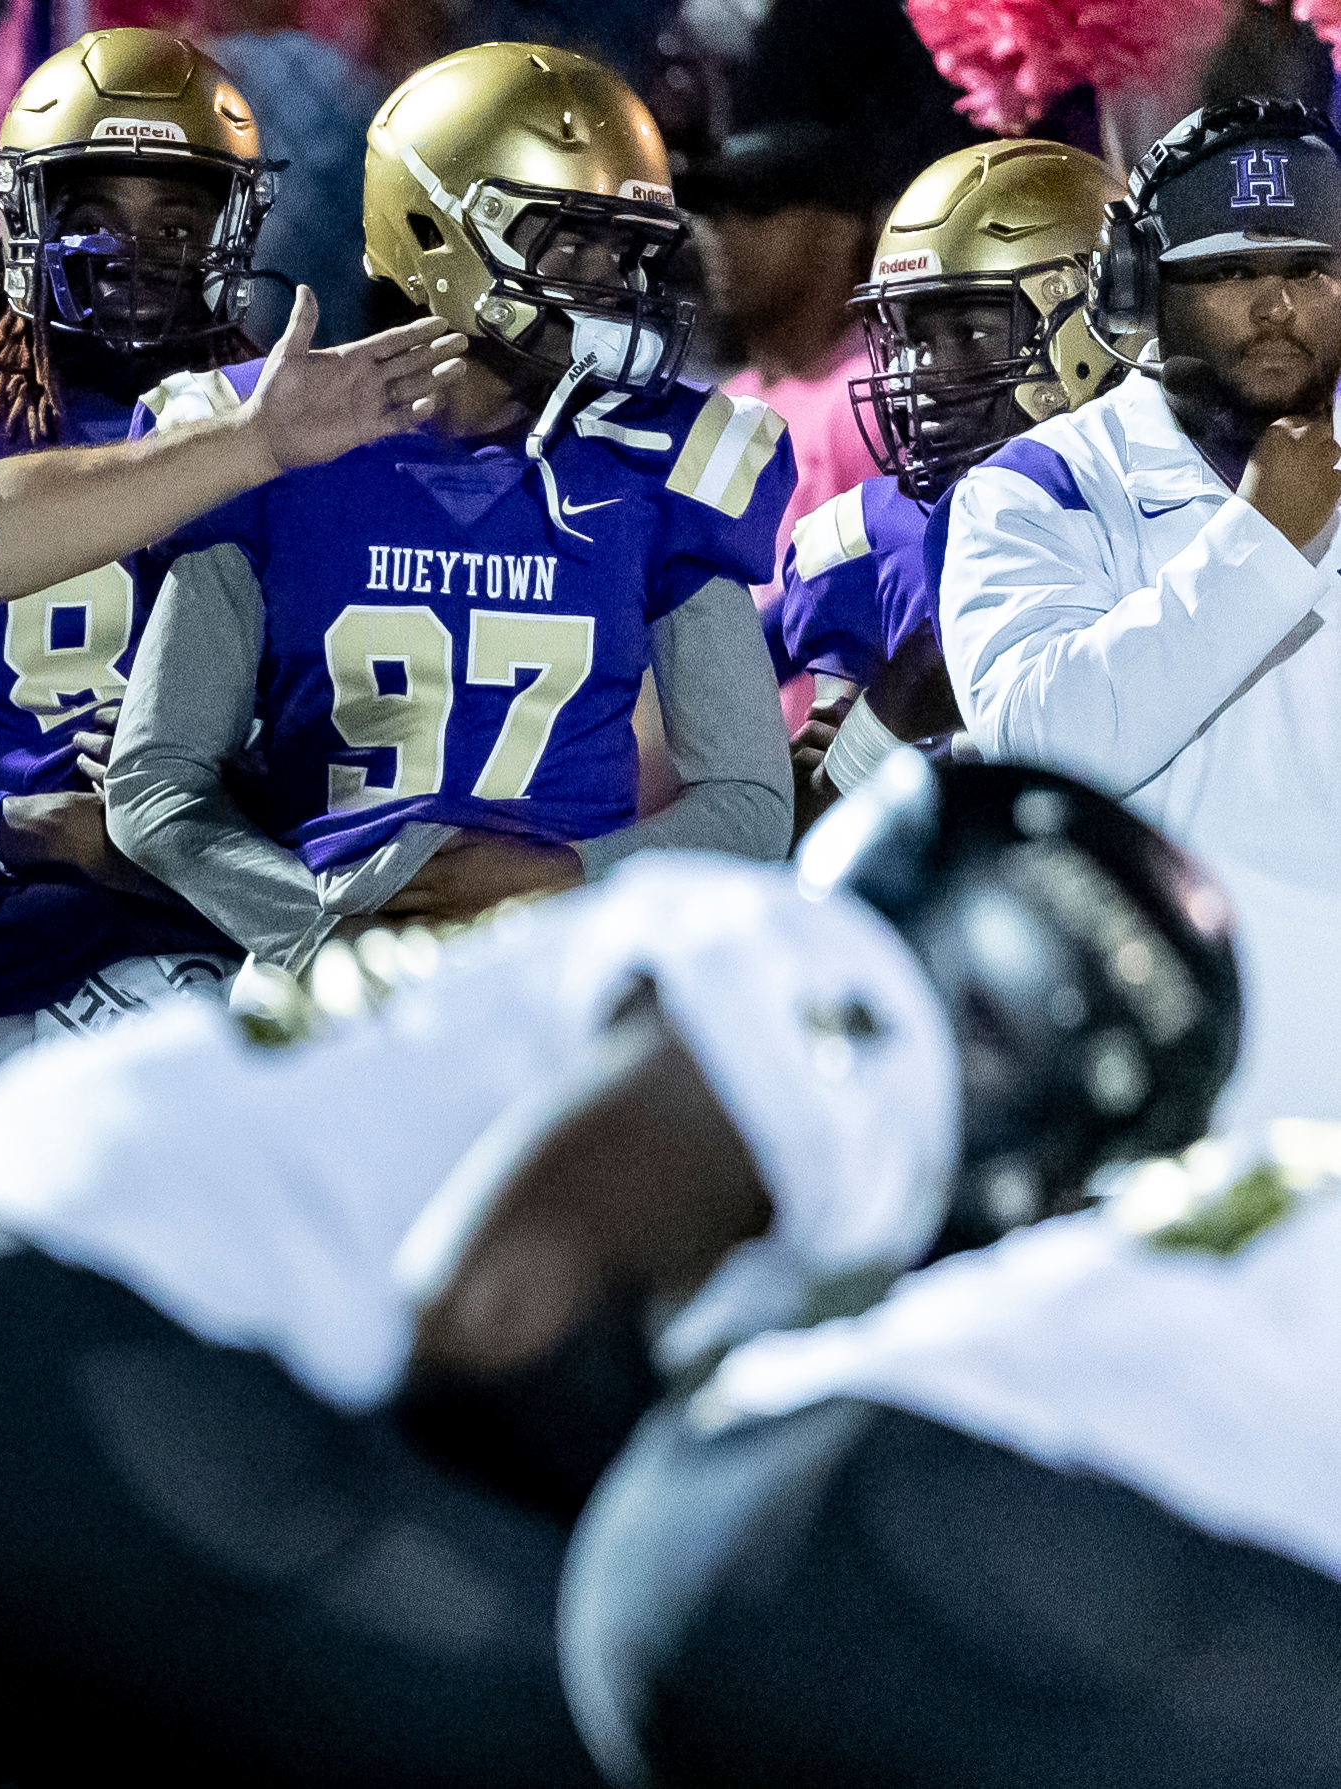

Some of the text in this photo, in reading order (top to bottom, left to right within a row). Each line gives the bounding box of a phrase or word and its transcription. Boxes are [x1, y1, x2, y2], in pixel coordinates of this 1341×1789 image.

[1229, 149, 1295, 208] H
[879, 256, 928, 276] Riddell
[568, 351, 598, 383] ADAMS
[366, 545, 557, 601] HUEYTOWN
[324, 604, 595, 814] 97
